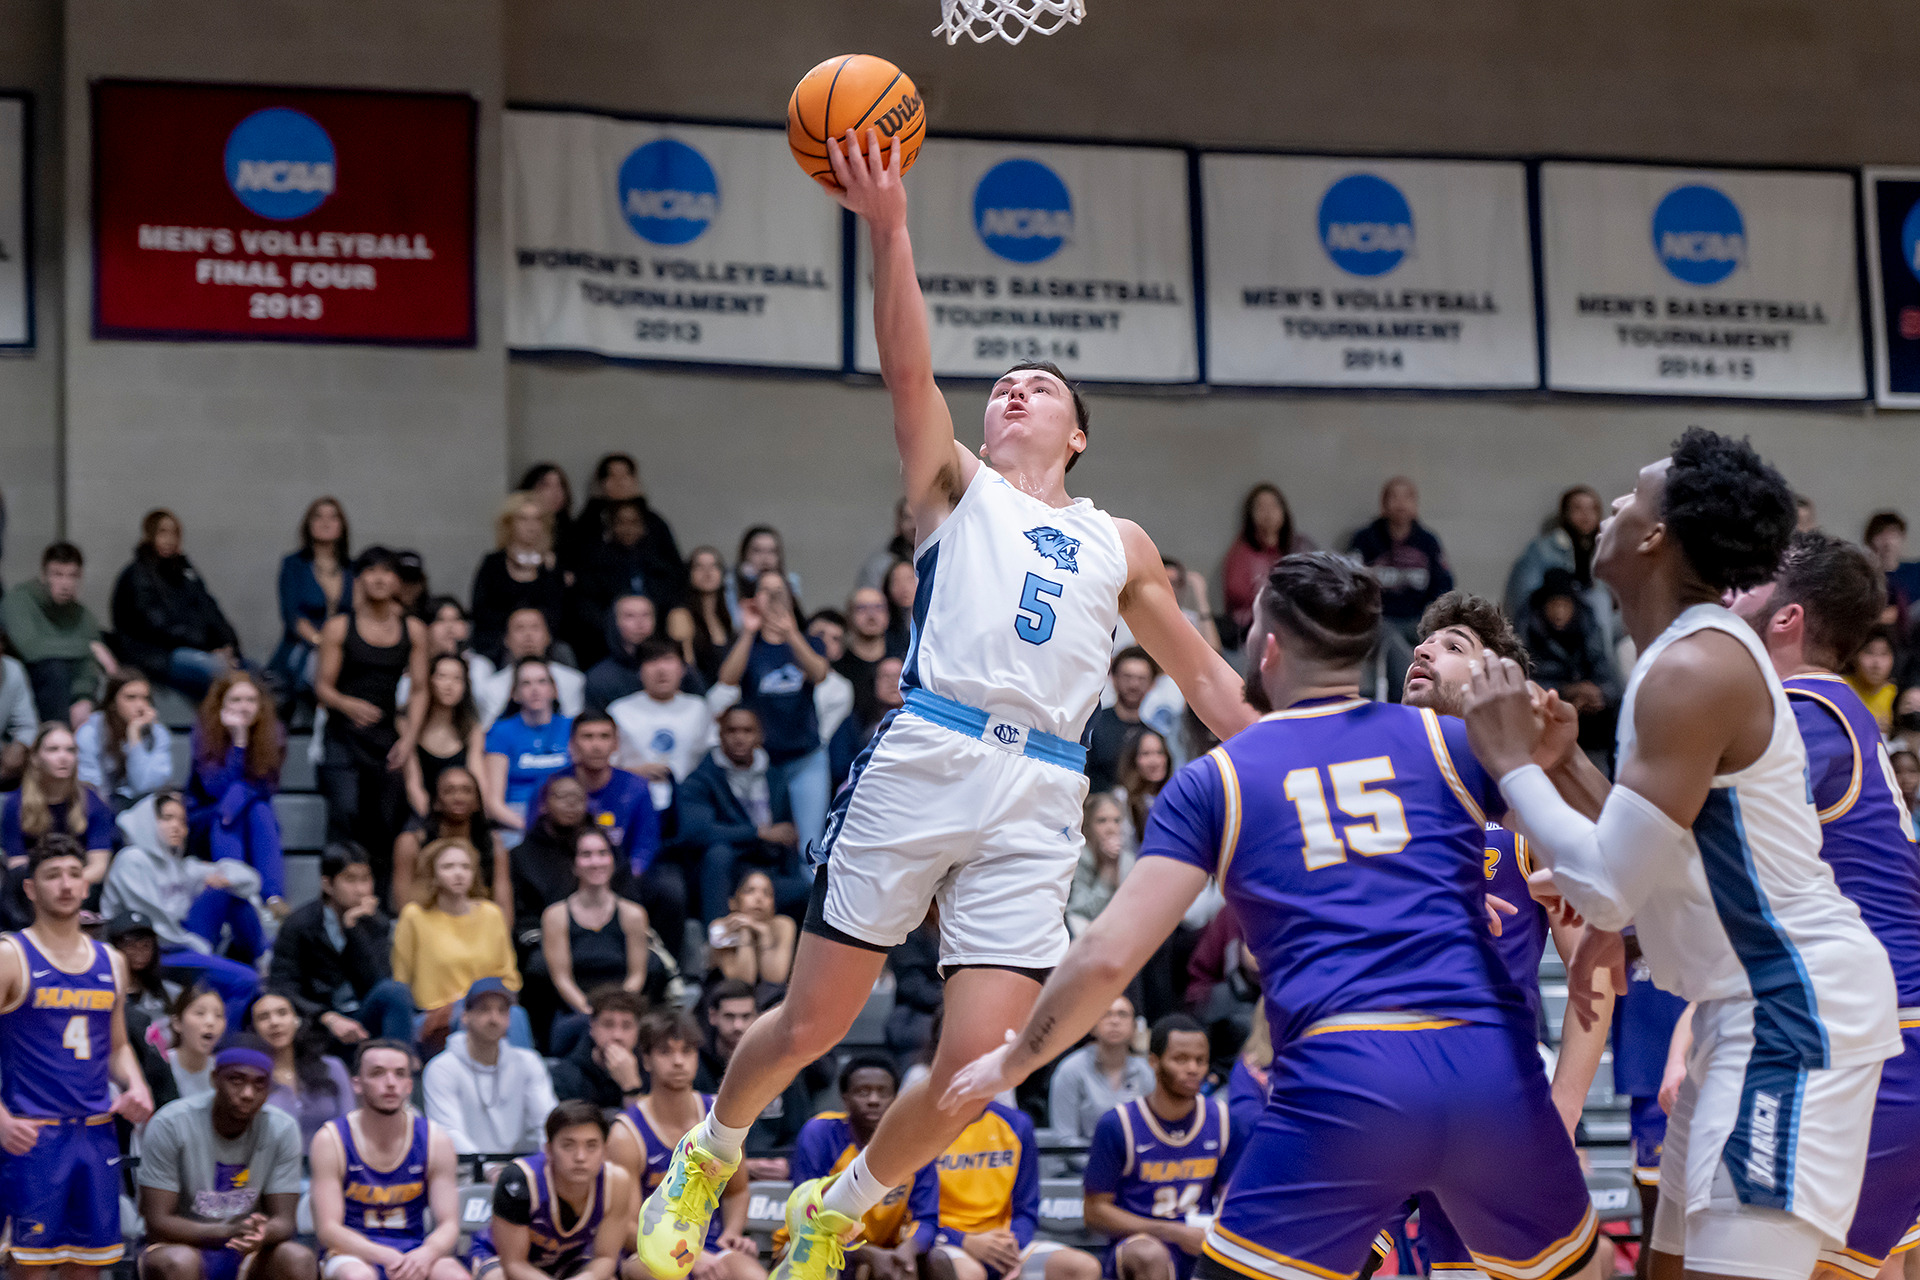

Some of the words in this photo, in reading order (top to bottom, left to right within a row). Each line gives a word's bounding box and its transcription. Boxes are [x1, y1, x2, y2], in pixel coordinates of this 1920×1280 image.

[236, 159, 335, 193] NCAA
[626, 188, 716, 221] NCAA
[982, 207, 1074, 239] NCAA
[1326, 222, 1415, 253] NCAA
[138, 224, 234, 254] MEN'S
[241, 228, 435, 260] VOLLEYBALL
[1661, 230, 1745, 263] NCAA
[196, 259, 285, 288] FINAL
[291, 262, 376, 290] FOUR
[516, 248, 641, 277] WOMEN'S
[650, 257, 829, 290] VOLLEYBALL
[580, 279, 766, 315] TOURNAMENT
[1007, 276, 1181, 305] BASKETBALL
[1241, 285, 1324, 310] MEN'S
[1332, 289, 1498, 315] VOLLEYBALL
[248, 293, 323, 320] 2013
[933, 304, 1123, 332] TOURNAMENT
[1576, 293, 1657, 318] MEN'S
[1666, 296, 1830, 326] BASKETBALL
[635, 318, 702, 344] 2013
[1281, 316, 1462, 342] TOURNAMENT
[1615, 323, 1792, 350] TOURNAMENT
[974, 336, 1079, 360] 2013-14
[1344, 348, 1404, 371] 2014
[1658, 354, 1755, 380] 2014-15
[1014, 571, 1063, 646] 5
[1283, 755, 1412, 872] 15
[32, 988, 116, 1011] HUNTER
[63, 1015, 91, 1060] 4
[1745, 1089, 1781, 1189] BARUCH
[935, 1150, 1014, 1171] HUNTER
[1140, 1158, 1218, 1183] HUNTER
